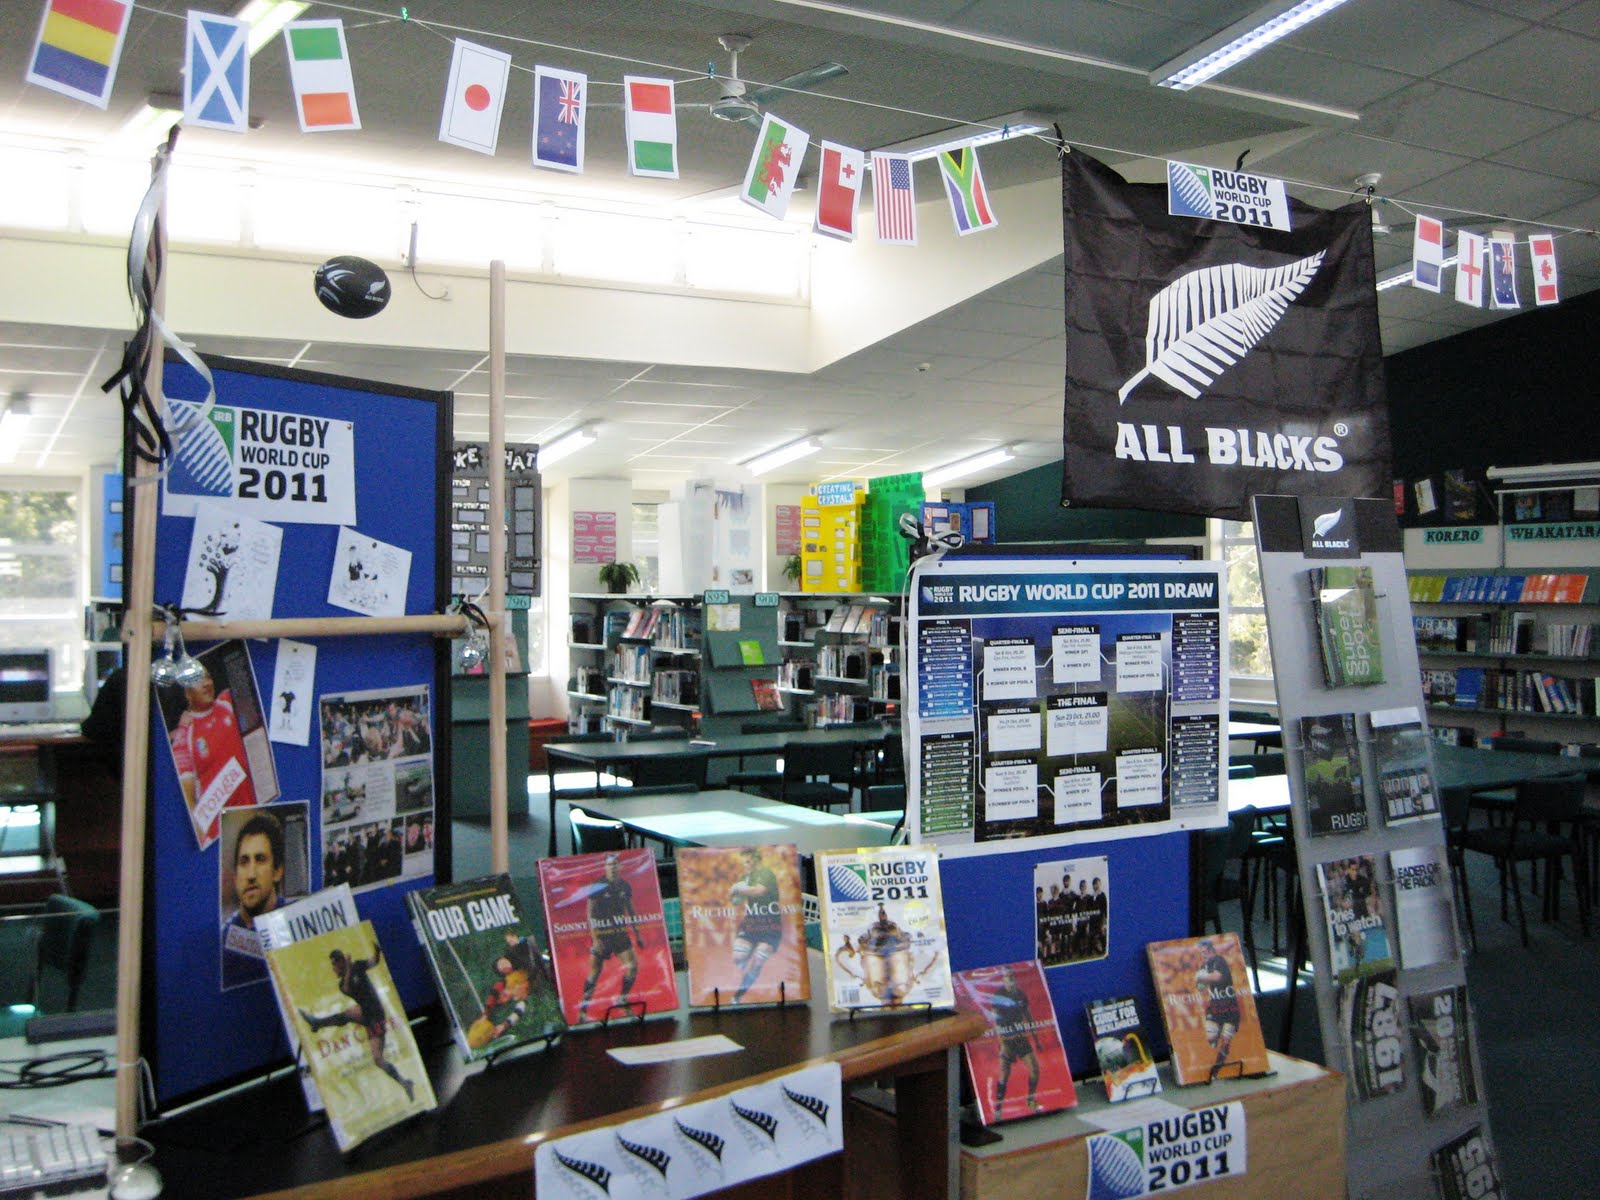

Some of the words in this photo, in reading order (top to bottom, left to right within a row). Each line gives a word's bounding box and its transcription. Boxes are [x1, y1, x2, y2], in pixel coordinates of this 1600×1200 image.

[1212, 170, 1267, 196] RUGBY
[1214, 190, 1251, 205] WORLD
[1253, 196, 1272, 208] CUP
[1215, 202, 1273, 227] 2011
[240, 410, 330, 449] RUGBY
[241, 446, 298, 468] WORLD
[302, 451, 330, 470] CUP
[1115, 422, 1195, 464] ALL
[1205, 427, 1343, 472] BLACKS
[238, 468, 328, 503] 2011
[818, 483, 853, 494] CREATING
[818, 493, 854, 505] CRYSTALS
[1426, 530, 1480, 542] KORERO
[959, 585, 1022, 602] RUGBY
[1025, 584, 1088, 601] WORLD
[1091, 583, 1124, 600] CUP
[1128, 583, 1160, 599] 2011
[1164, 582, 1214, 599] DRAW
[1057, 698, 1073, 707] THE
[1073, 696, 1098, 706] FINAL
[868, 860, 927, 876] RUGBY
[1398, 864, 1426, 879] EADER
[871, 877, 906, 886] WORLD
[908, 876, 928, 884] CUP
[872, 886, 929, 900] 2011
[288, 900, 349, 942] UNION
[428, 901, 470, 941] OUR
[467, 894, 520, 933] GAME
[554, 921, 587, 933] SONNY
[590, 917, 612, 930] BILL
[613, 913, 663, 926] WILLIAMS
[1373, 982, 1403, 1088] 1987
[1148, 1106, 1230, 1147] RUGBY
[1148, 1142, 1200, 1164] WORLD
[1204, 1134, 1232, 1151] CUP
[1148, 1152, 1230, 1192] 2011
